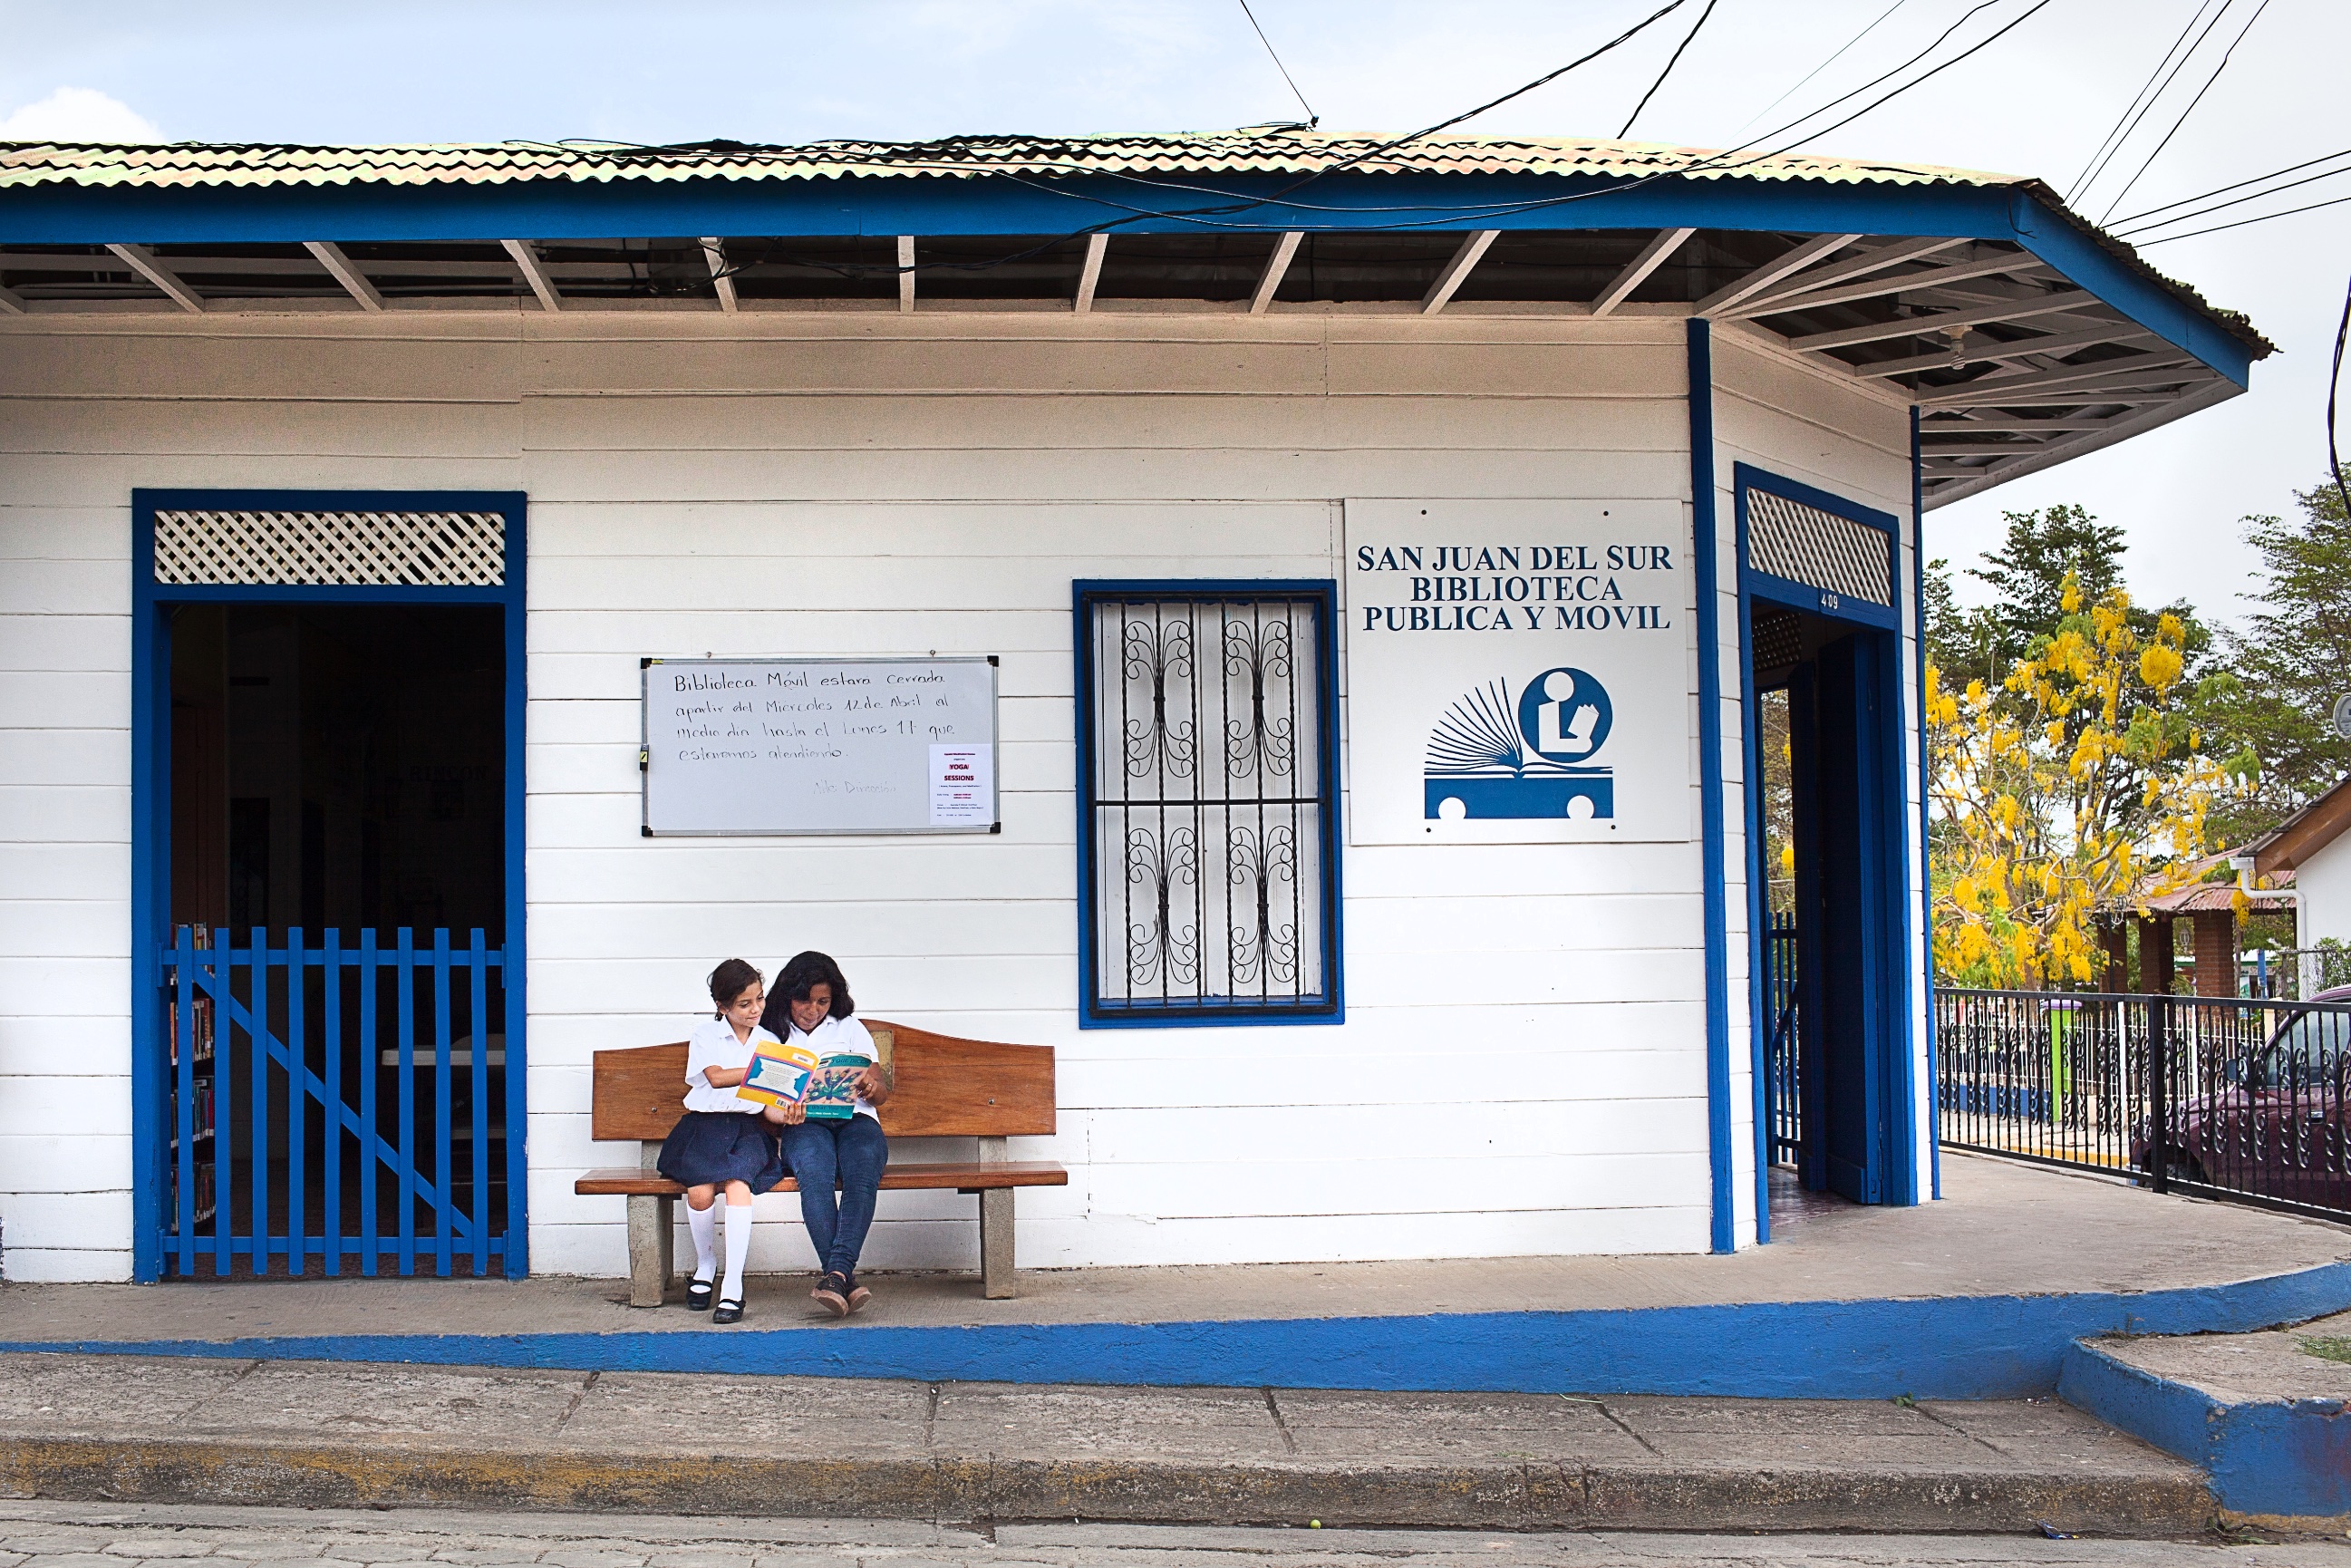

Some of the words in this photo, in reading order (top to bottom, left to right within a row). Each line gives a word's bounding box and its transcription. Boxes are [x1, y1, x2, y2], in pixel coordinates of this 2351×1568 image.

[1357, 546, 1424, 572] SAN
[1432, 546, 1521, 572] JUAN
[1529, 546, 1598, 571] DEL
[1606, 545, 1674, 571] SUR
[1409, 576, 1623, 602] BIBLIOTECA
[1821, 593, 1838, 610] 409
[1362, 605, 1514, 631] PUBLICA
[1522, 606, 1545, 630] Y
[1554, 605, 1671, 630] MOVIL
[674, 672, 757, 692] Biblioteca
[768, 671, 808, 688] Móvil
[675, 701, 724, 722] apartir
[732, 701, 753, 713] del
[865, 695, 884, 709] de
[890, 693, 921, 707] Abril
[935, 693, 949, 707] al
[762, 721, 807, 739] hasta
[815, 721, 829, 737] el
[928, 724, 955, 741] que
